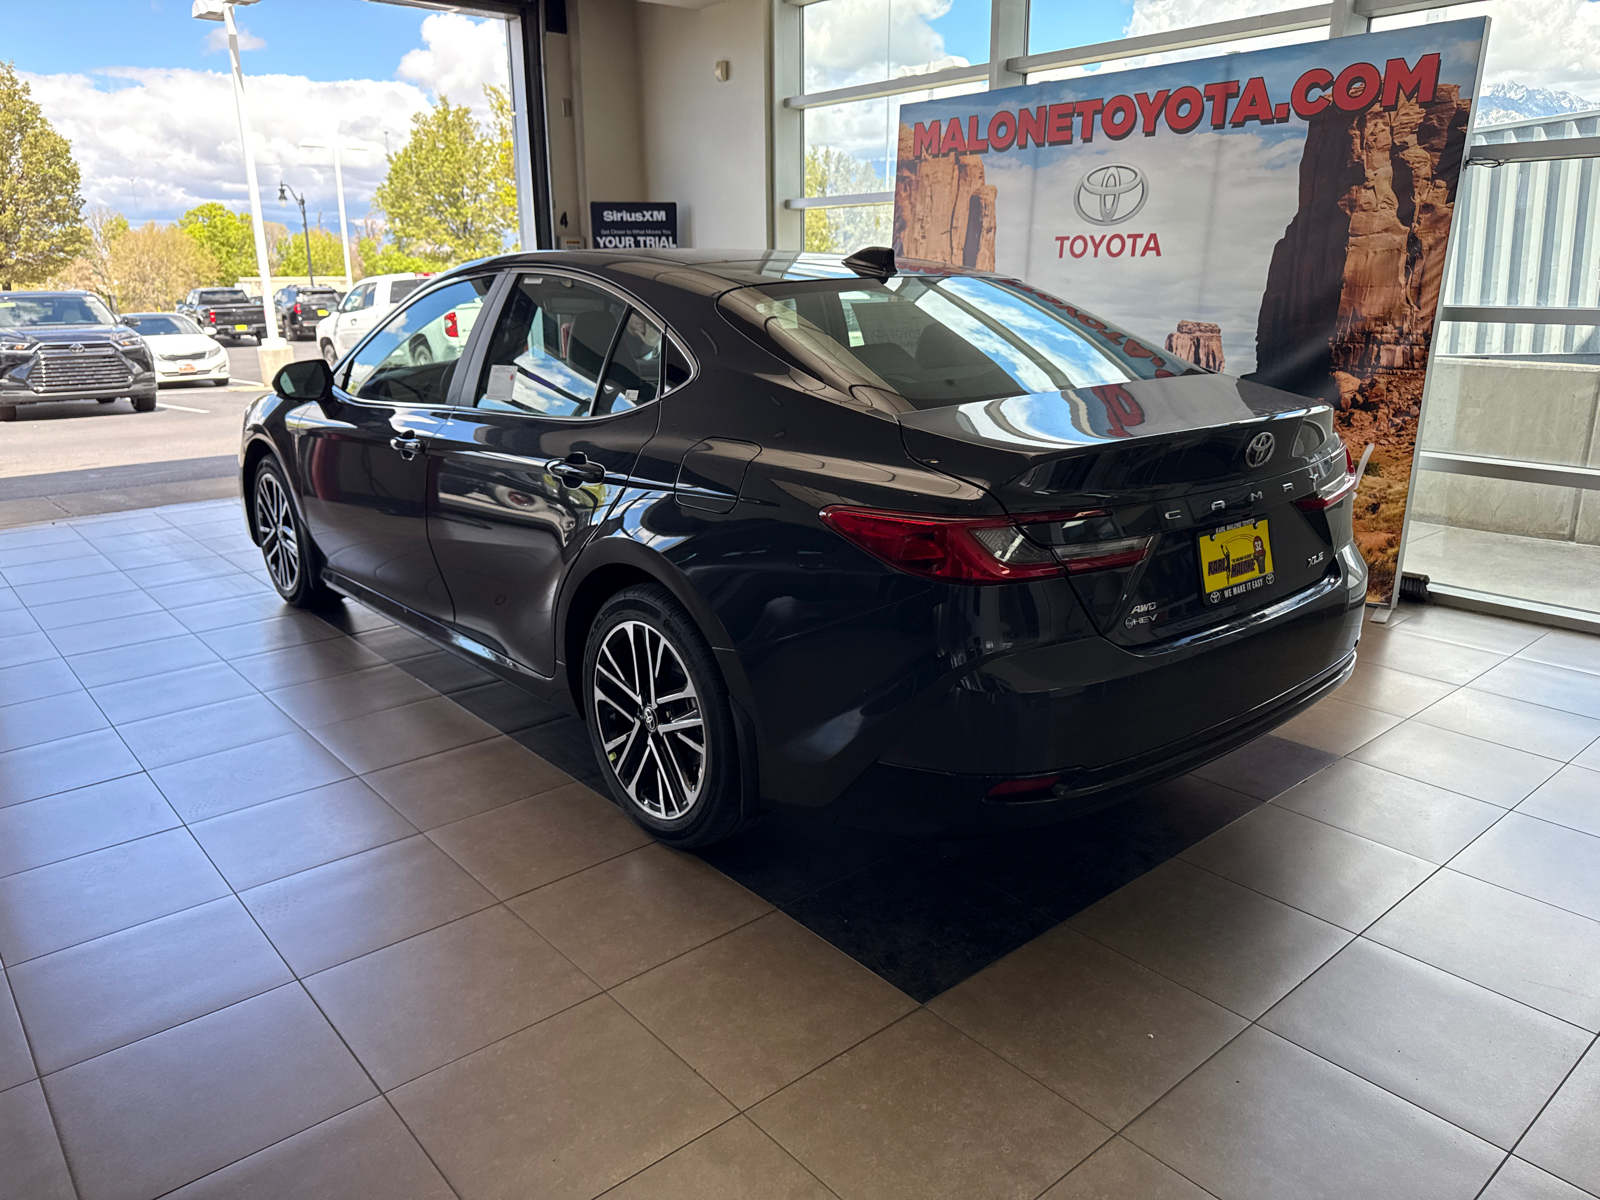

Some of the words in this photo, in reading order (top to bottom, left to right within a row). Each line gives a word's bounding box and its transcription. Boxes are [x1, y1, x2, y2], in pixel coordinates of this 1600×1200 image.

[912, 52, 1442, 160] MALONETOYOTA.COM
[560, 211, 568, 228] 4
[603, 210, 666, 222] SiriusXM
[596, 236, 635, 248] YOUR
[637, 236, 677, 248] TRIAL
[1055, 233, 1162, 259] TOYOTA
[1164, 473, 1319, 520] CAMRY
[1254, 540, 1262, 551] 32
[1208, 557, 1225, 576] KARL
[1307, 551, 1324, 568] XLE
[1223, 589, 1233, 598] WE
[1232, 584, 1247, 595] MAKE
[1246, 582, 1252, 591] IT
[1252, 578, 1263, 589] EASY
[1130, 601, 1157, 614] AWD
